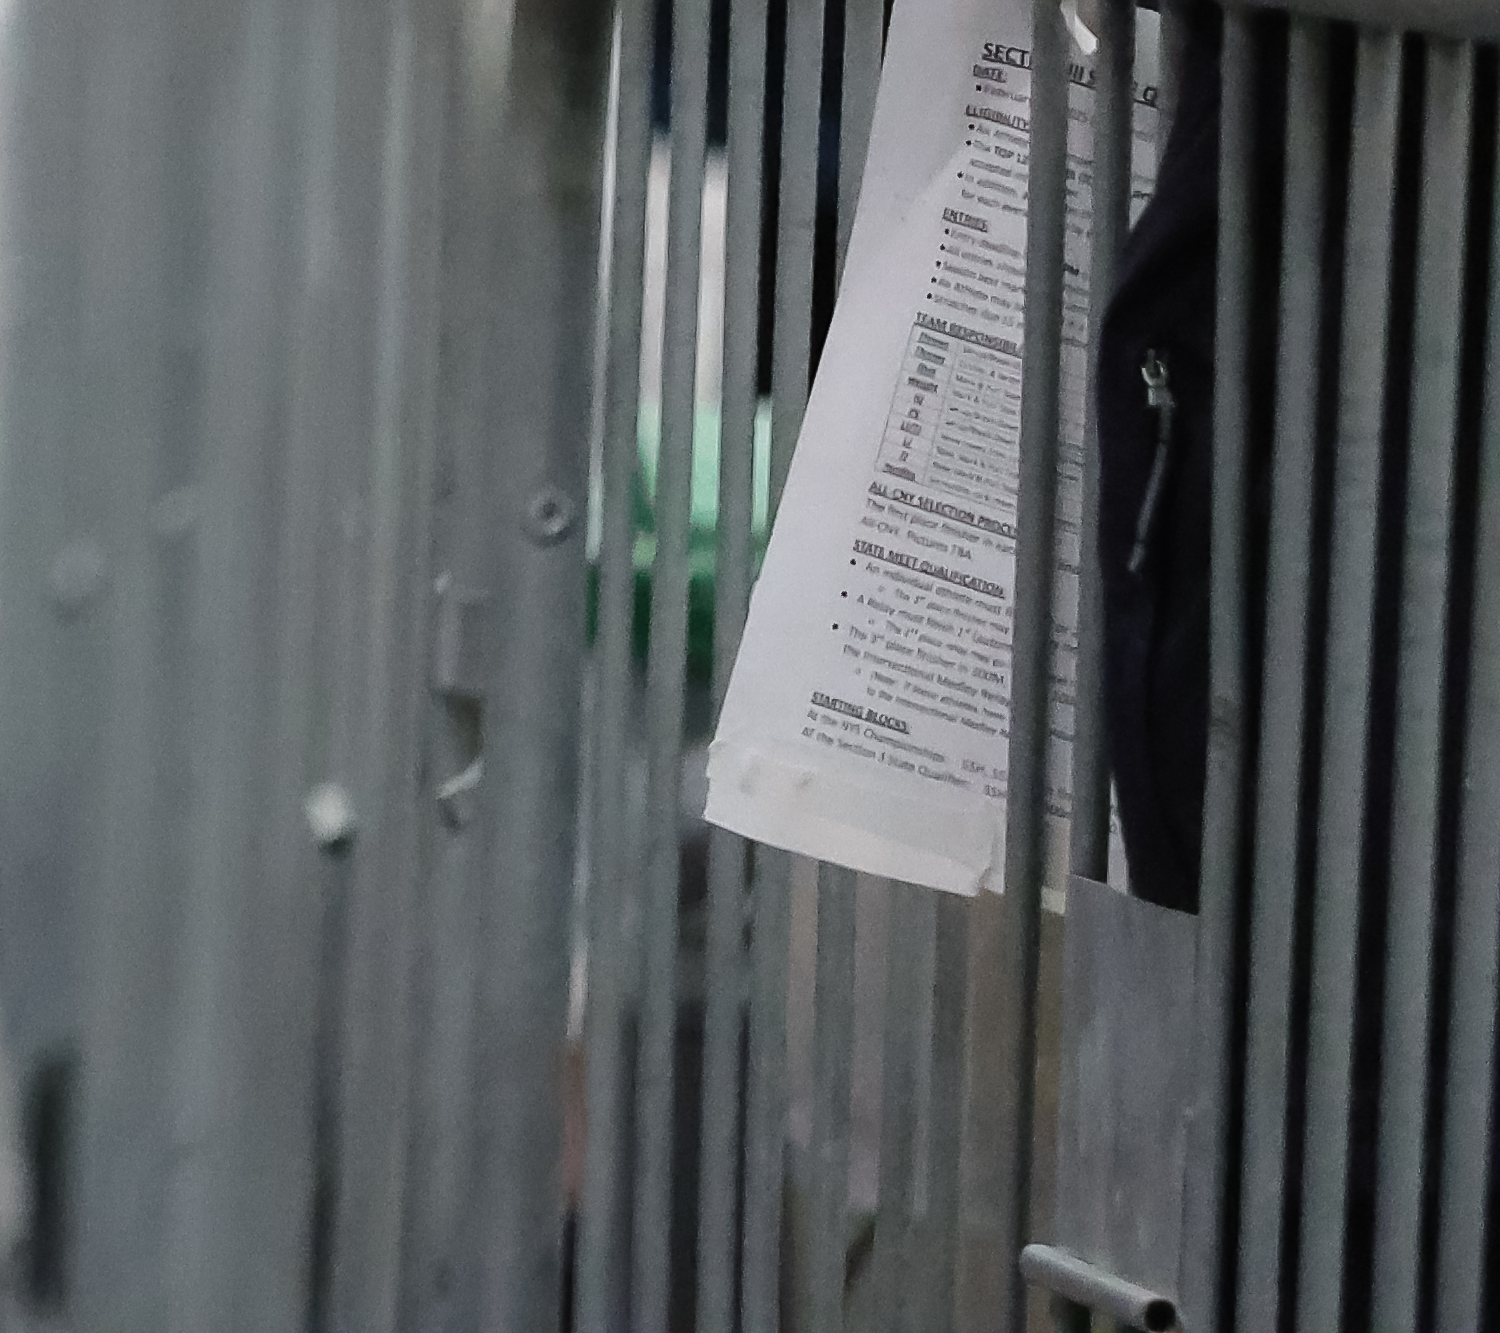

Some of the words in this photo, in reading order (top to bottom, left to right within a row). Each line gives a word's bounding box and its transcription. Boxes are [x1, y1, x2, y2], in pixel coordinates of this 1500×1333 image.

[982, 42, 1032, 70] SECT
[913, 312, 947, 334] TEAM
[868, 481, 887, 498] ALL
[890, 489, 915, 506] CNY
[915, 496, 975, 526] SELECTION
[853, 539, 884, 560] STATE
[886, 550, 918, 571] MEET
[811, 692, 863, 720] STARTING
